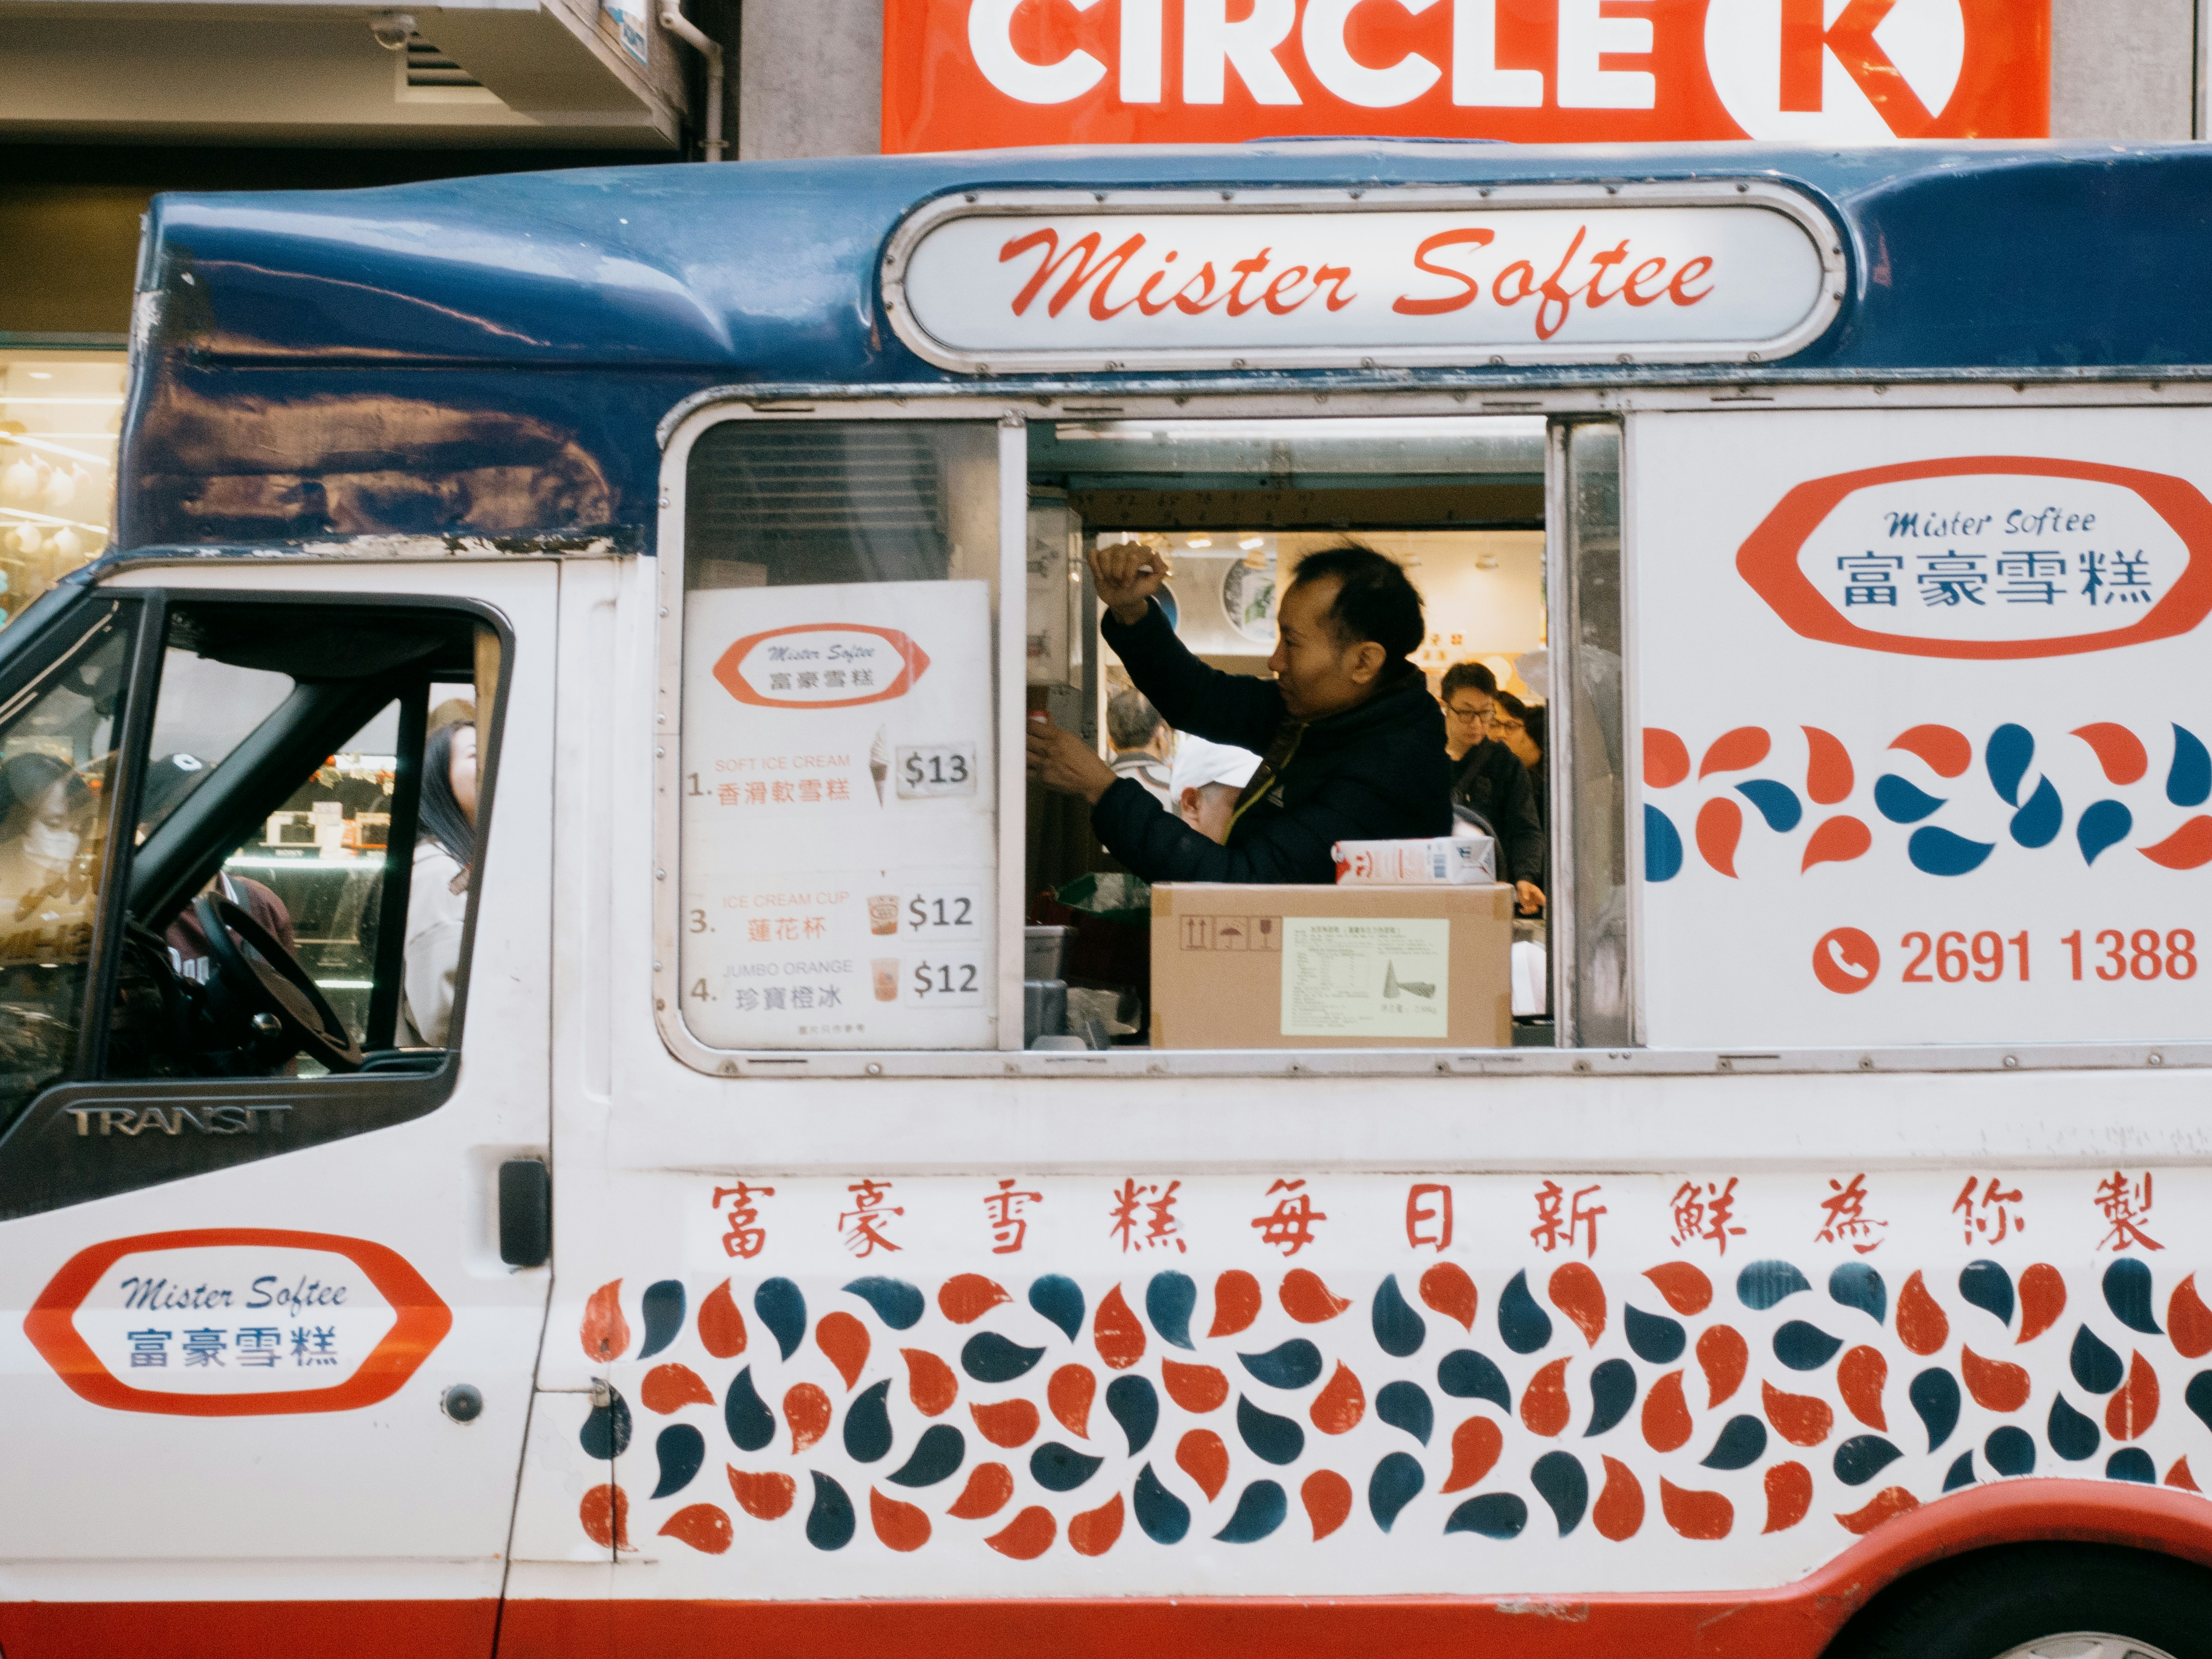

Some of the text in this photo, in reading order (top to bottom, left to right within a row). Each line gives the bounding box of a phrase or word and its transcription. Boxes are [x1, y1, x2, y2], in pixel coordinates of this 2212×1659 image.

[968, 0, 1656, 109] CIRCLE
[998, 225, 1715, 341] Mister Softee
[1884, 506, 2096, 539] Mister Softee
[1836, 549, 2154, 607] 富豪雪糕
[715, 755, 851, 773] SOFT ICE CREAM
[905, 752, 969, 787] $13
[687, 772, 712, 796] 1.
[717, 778, 851, 806] 香滑軟雪糕
[722, 890, 851, 909] ICE CREAM CUP
[909, 894, 973, 932] $12
[690, 909, 715, 933] 3.
[747, 916, 826, 942] 蓮花杯
[723, 959, 853, 978] JUMBO ORANGE
[1900, 928, 2198, 983] 2691 1388
[690, 977, 717, 1001] 4.
[914, 961, 979, 998] $12
[736, 985, 842, 1011] 珍寶橙冰
[66, 1104, 293, 1136] TRANSIT
[121, 1275, 348, 1318] Mister Softee
[127, 1326, 338, 1367] 富豪雪糕
